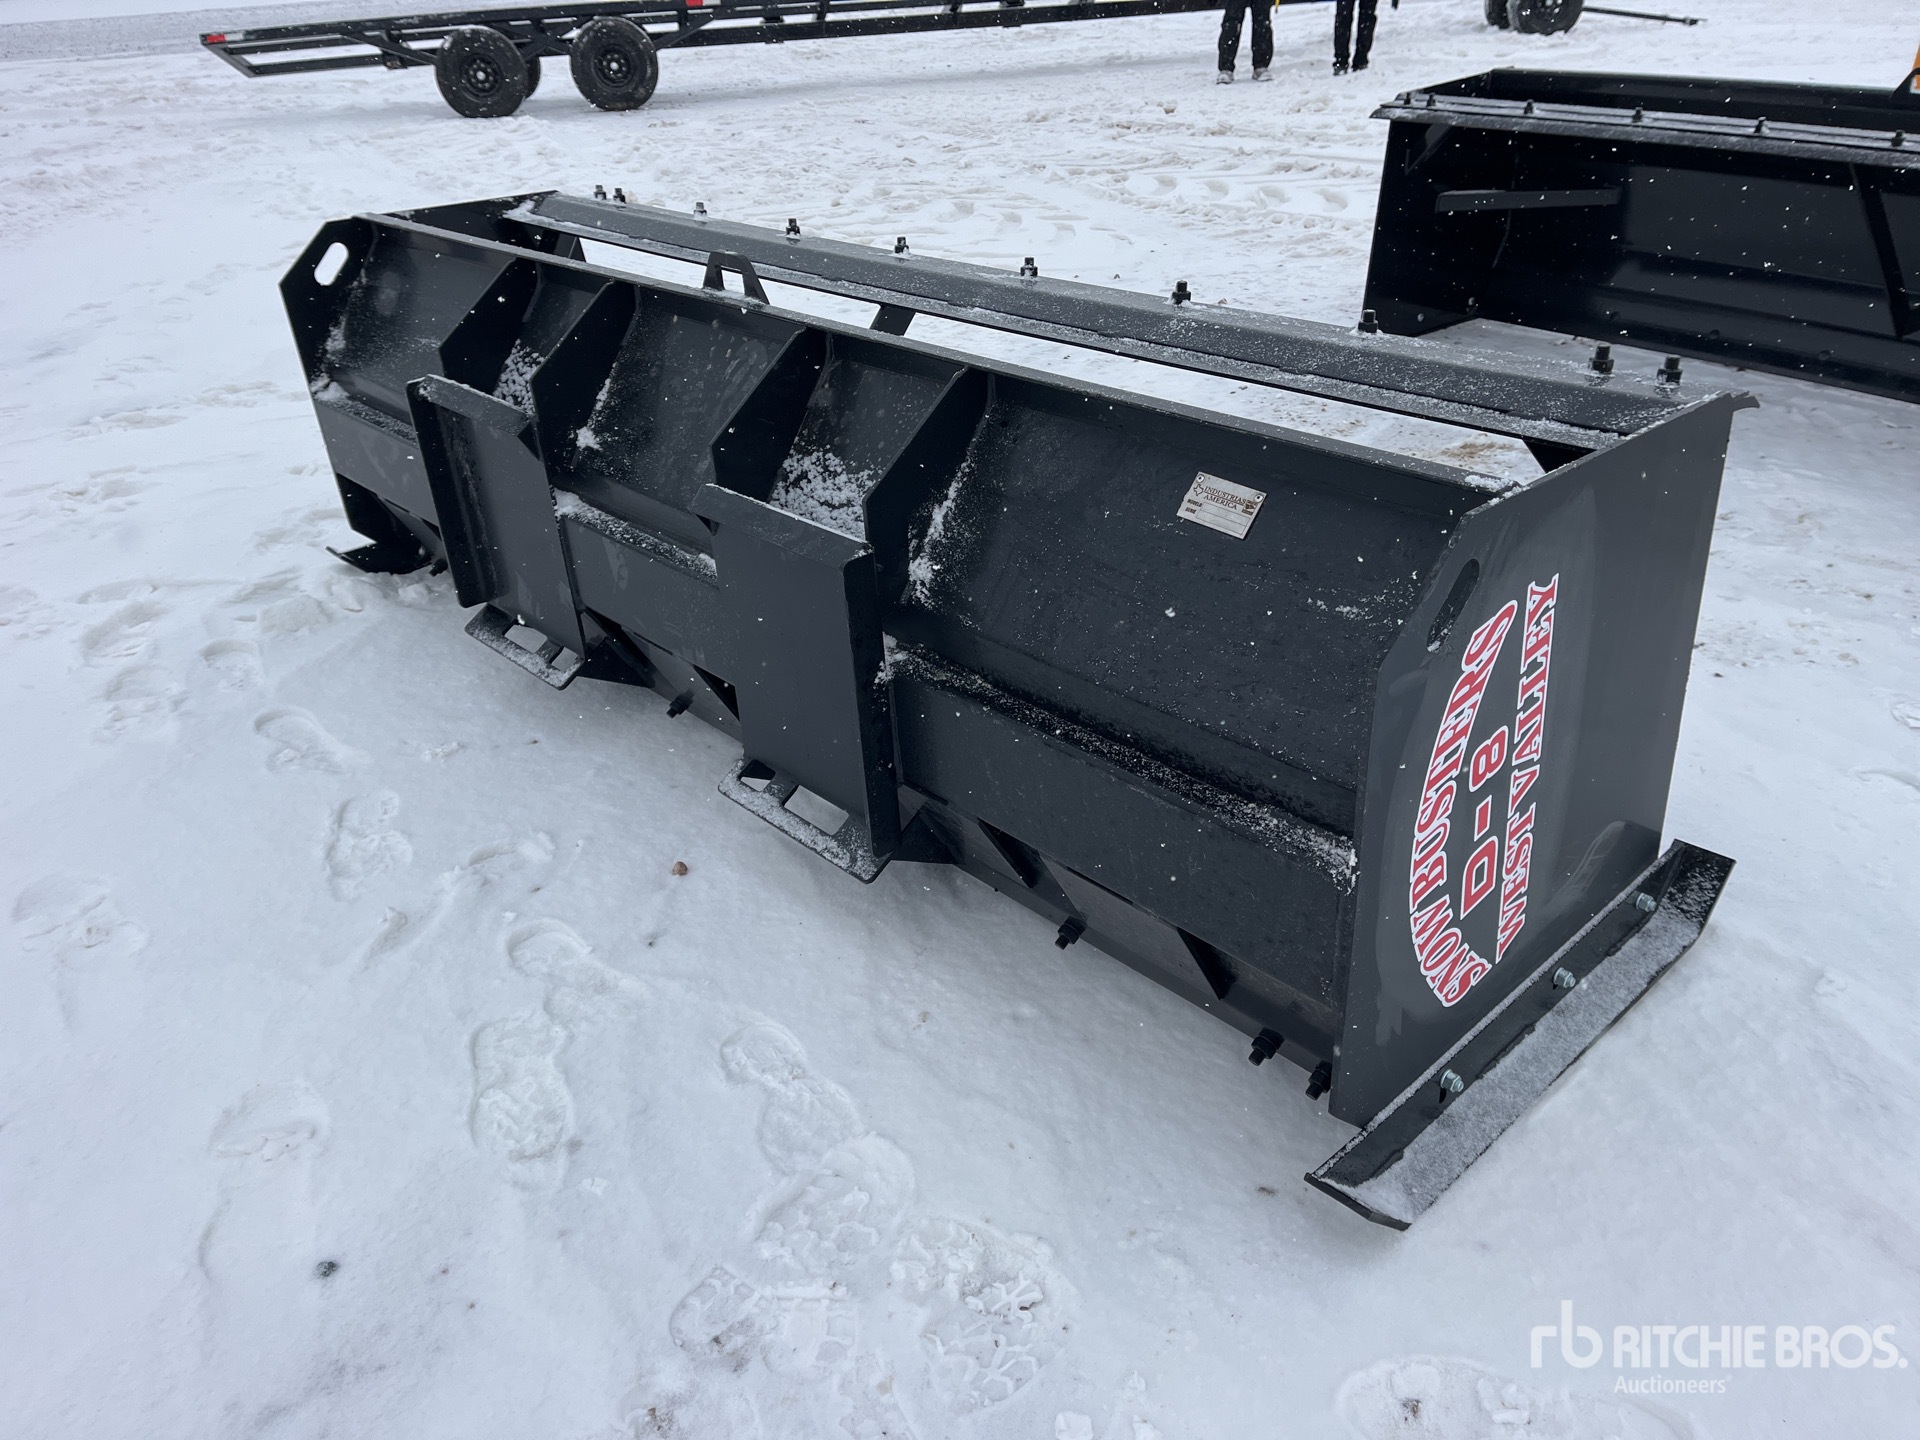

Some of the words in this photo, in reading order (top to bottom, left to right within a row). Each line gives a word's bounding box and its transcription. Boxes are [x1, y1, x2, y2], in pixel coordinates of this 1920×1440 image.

[1204, 486, 1246, 504] INDUSTRIAS
[1204, 494, 1237, 510] AMERICA
[1409, 600, 1518, 914] BUSTERS
[1510, 573, 1560, 813] VALLEY
[1410, 893, 1492, 1007] SNOW
[1496, 802, 1536, 964] WEST
